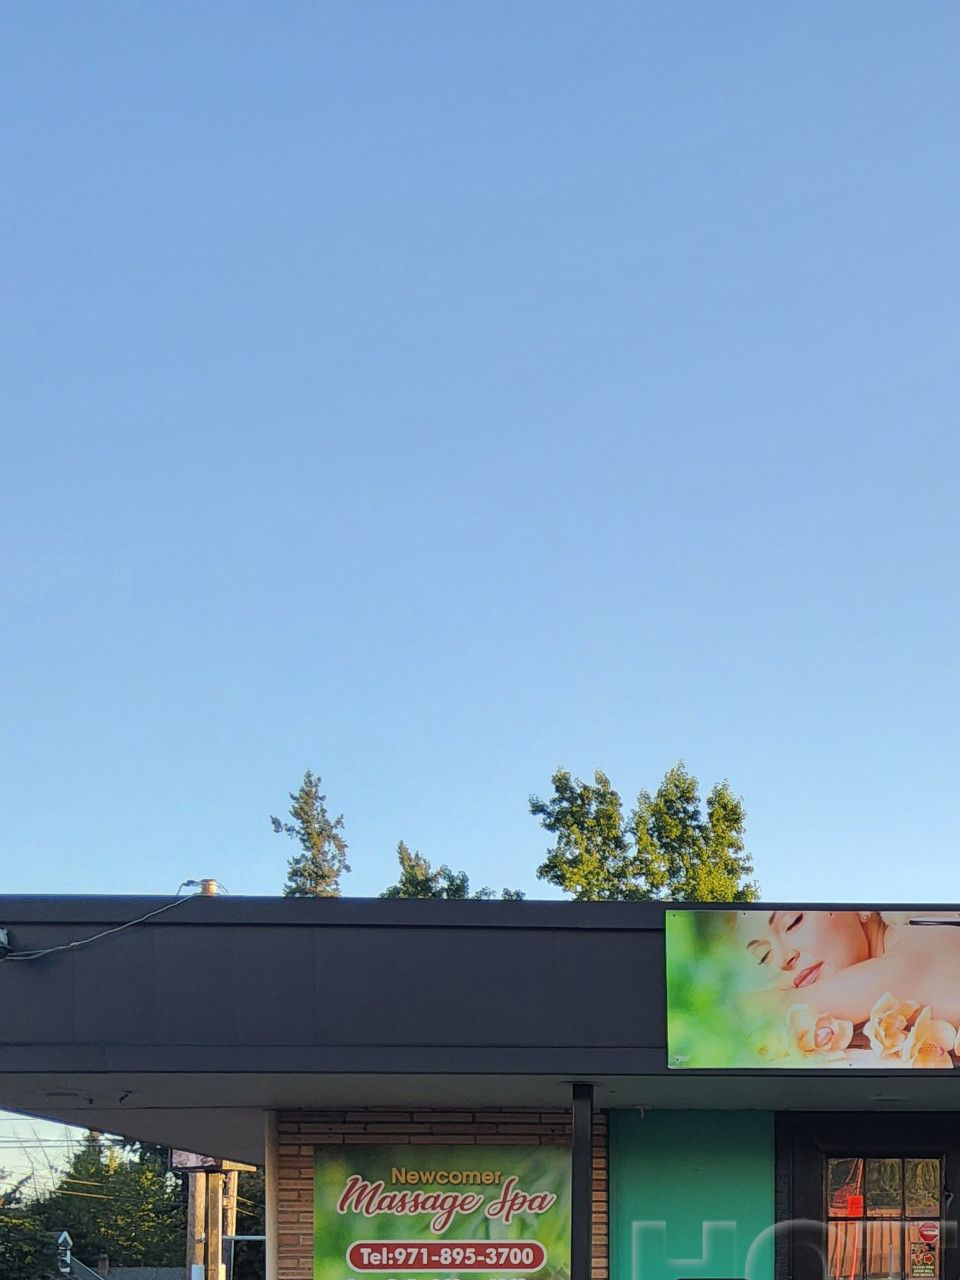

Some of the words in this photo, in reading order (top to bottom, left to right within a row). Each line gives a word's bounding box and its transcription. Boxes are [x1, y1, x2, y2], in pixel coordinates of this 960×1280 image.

[391, 1168, 501, 1185] Newcomer
[339, 1177, 481, 1233] Massage
[487, 1177, 556, 1223] Spa
[360, 1247, 534, 1266] Tel:971-895-3700
